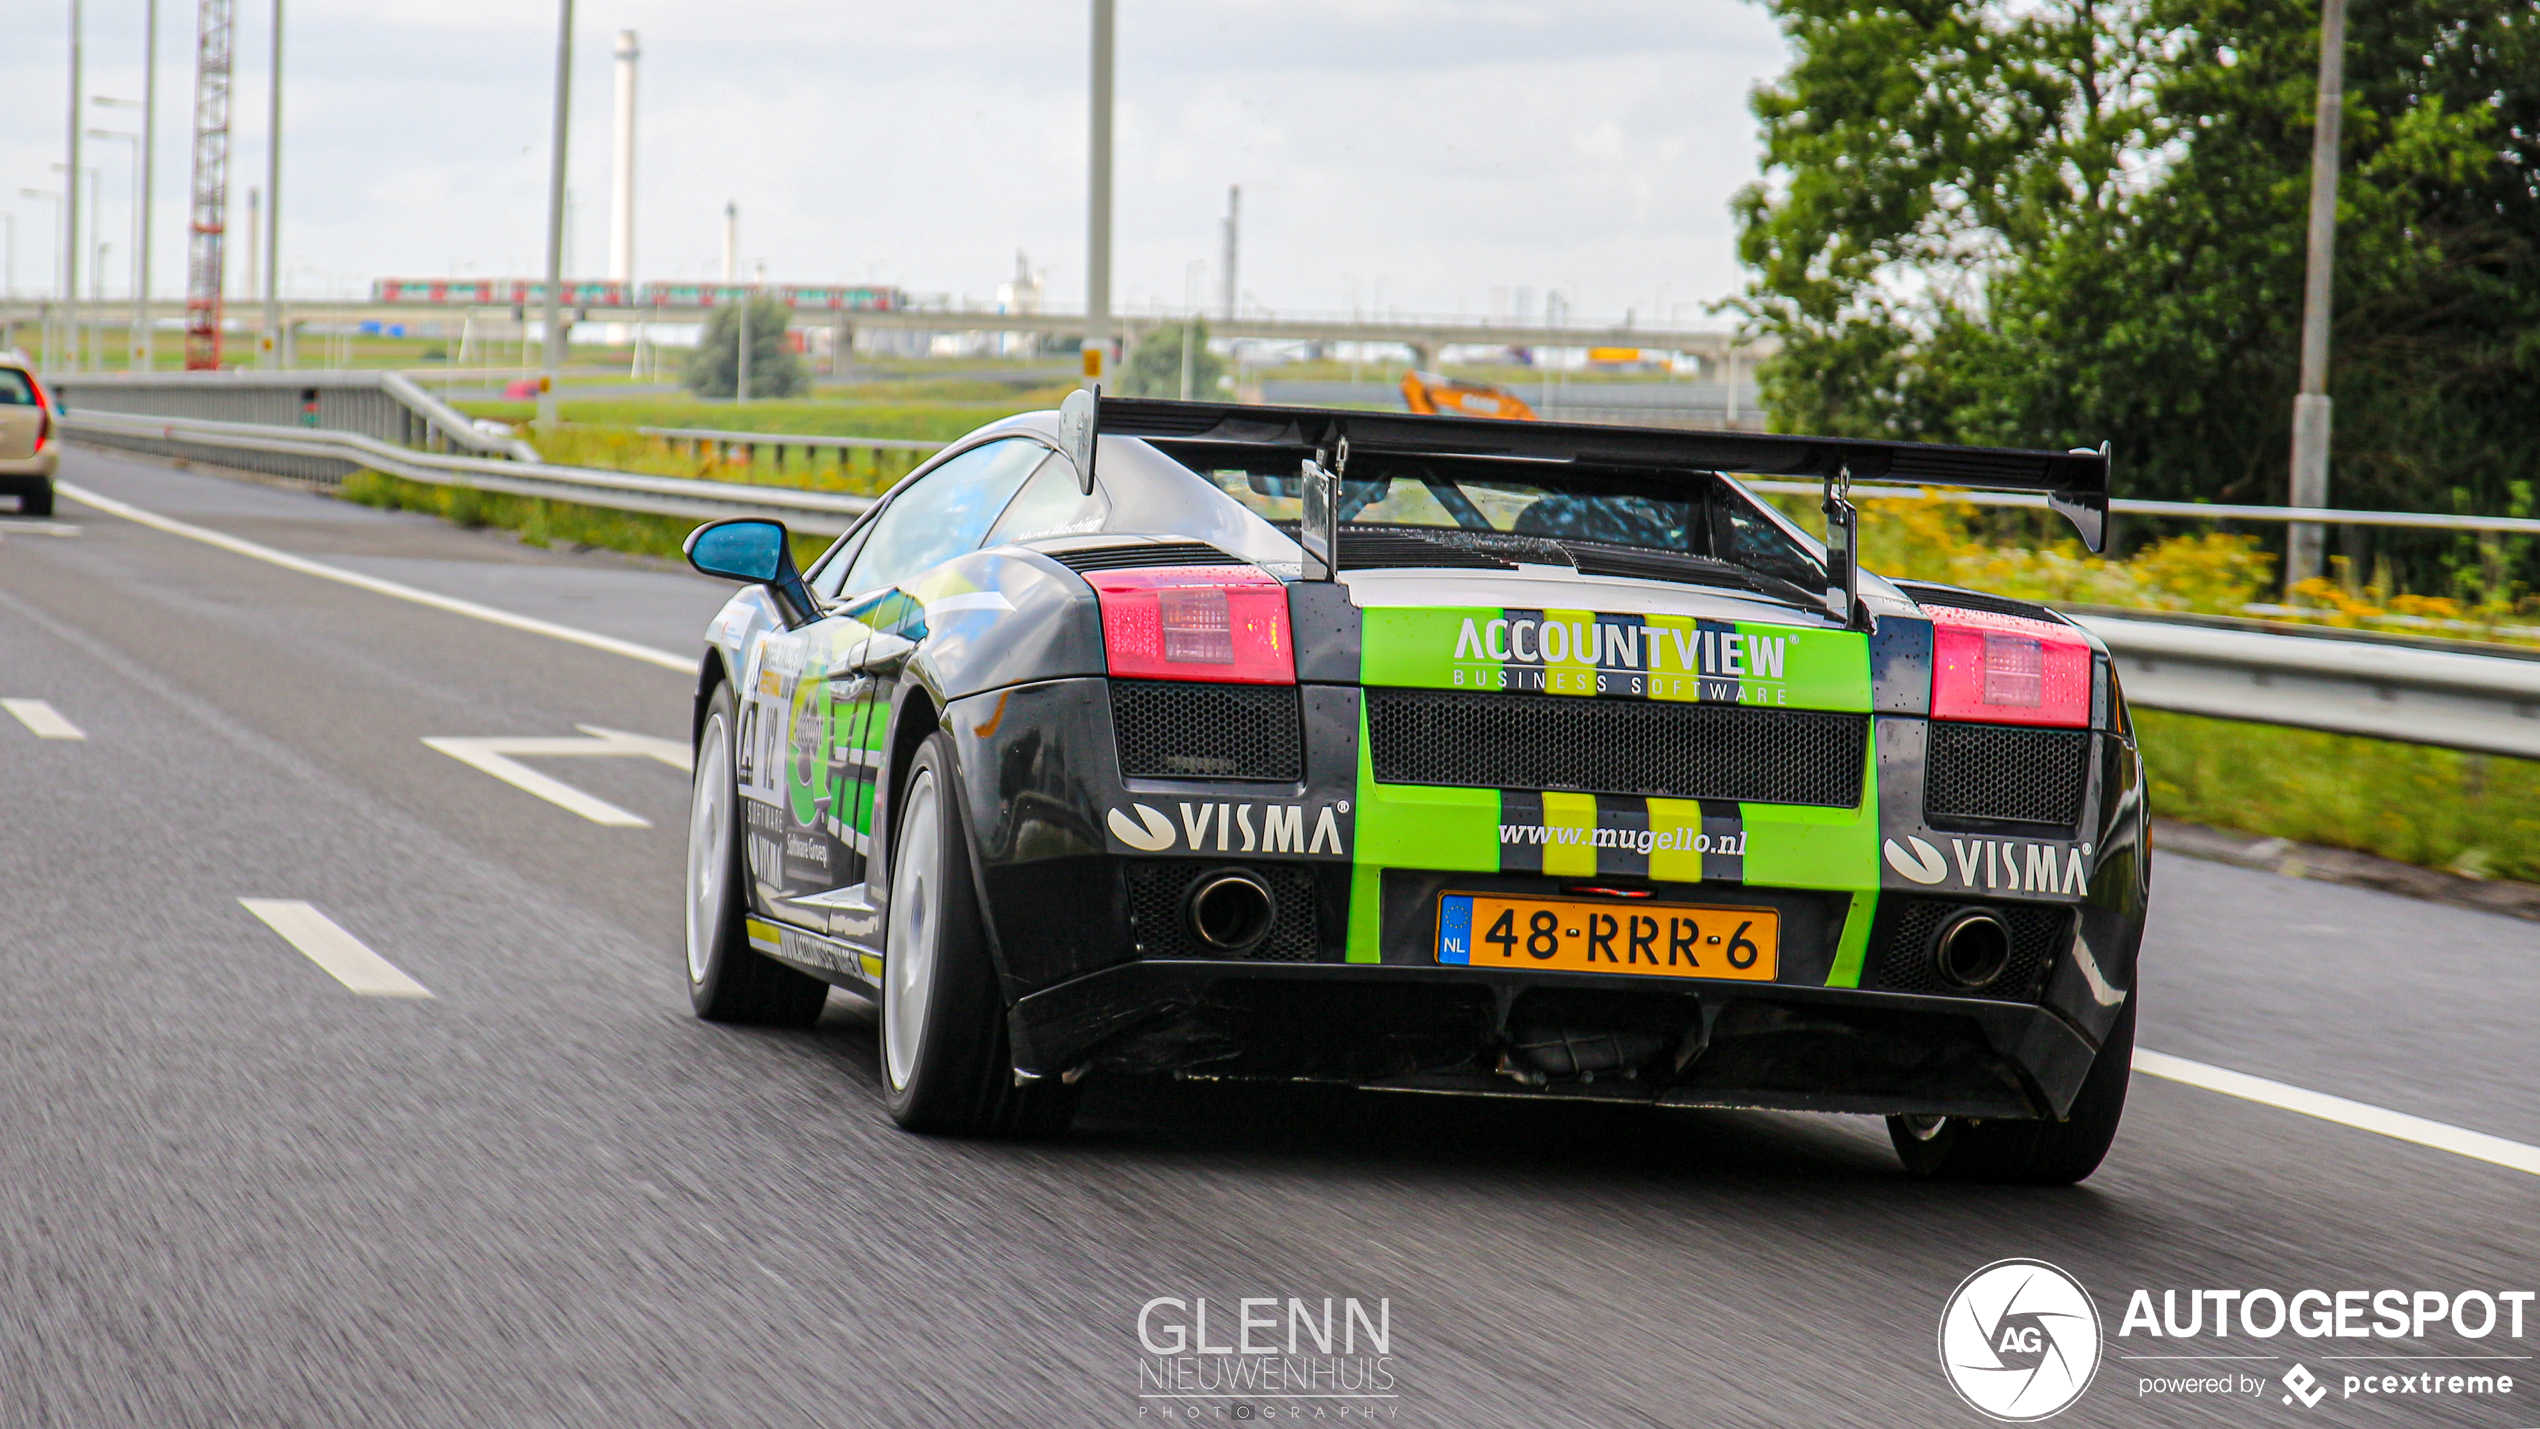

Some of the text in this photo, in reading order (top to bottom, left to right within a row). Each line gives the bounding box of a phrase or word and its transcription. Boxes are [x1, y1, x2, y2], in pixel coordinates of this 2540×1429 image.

[1454, 617, 1785, 678] ACCOUNTVIEW
[1453, 669, 1786, 705] BUSINESS SOFTWARE
[747, 800, 783, 833] SOFTWARE
[786, 833, 828, 868] Software Groep
[1498, 824, 1749, 855] www.mugello.nl
[758, 833, 783, 891] VISMA
[1443, 908, 1759, 970] NL 48-RRR-6
